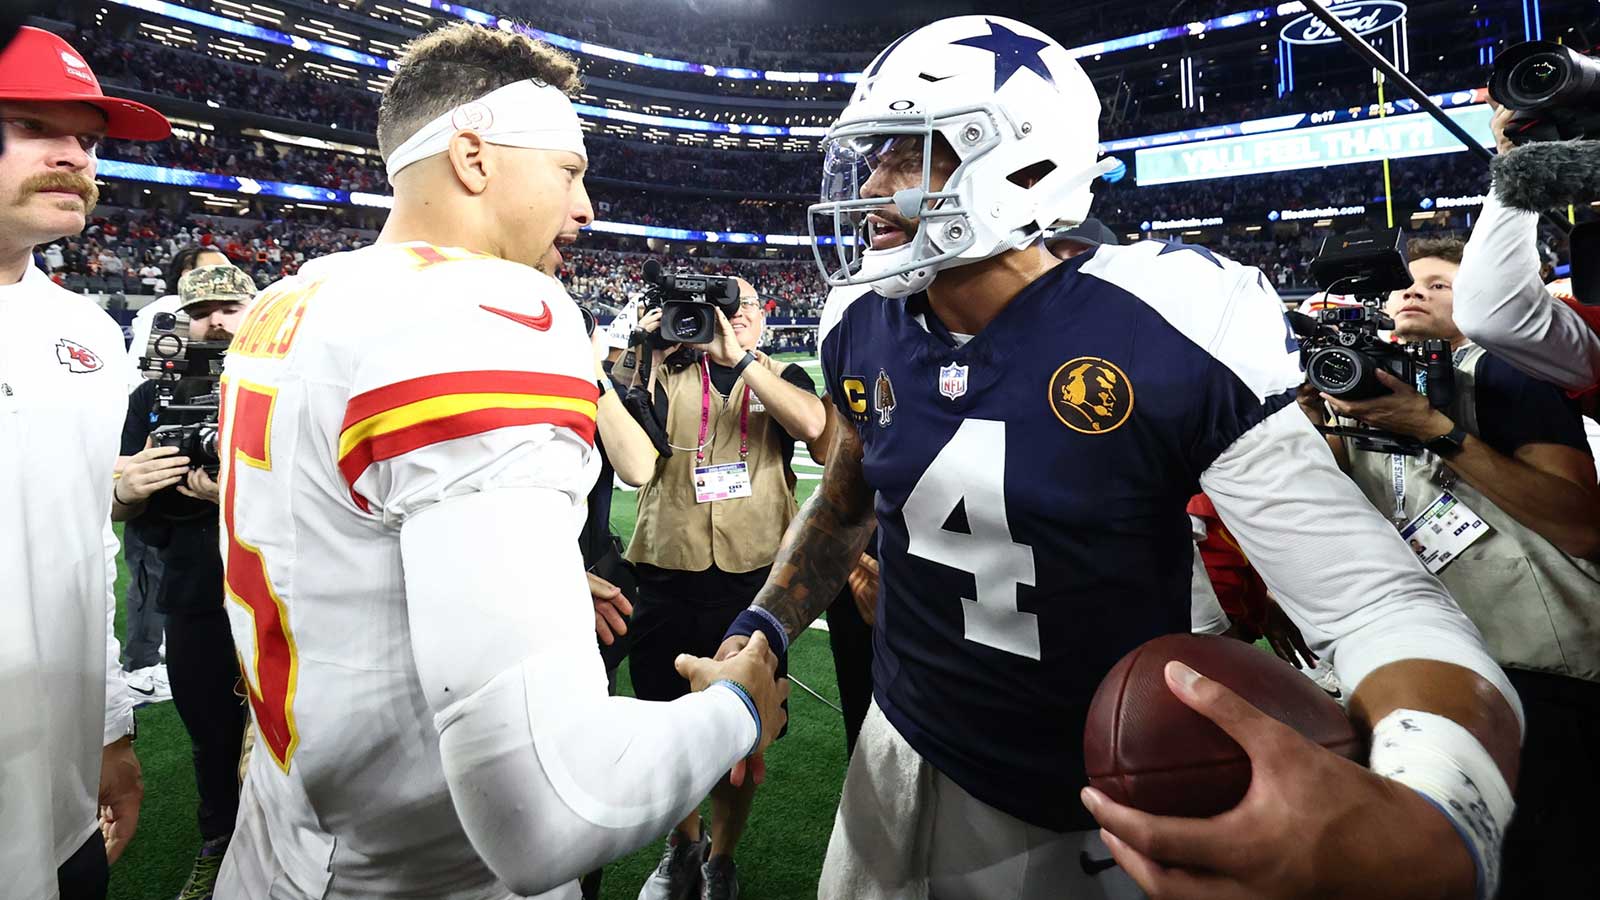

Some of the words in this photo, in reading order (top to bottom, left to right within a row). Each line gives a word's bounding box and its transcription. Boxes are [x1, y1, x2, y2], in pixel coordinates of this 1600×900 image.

[1254, 135, 1320, 167] FEEL
[843, 379, 867, 413] C
[944, 380, 962, 393] NFL
[749, 404, 766, 413] MED
[901, 417, 1042, 662] 4
